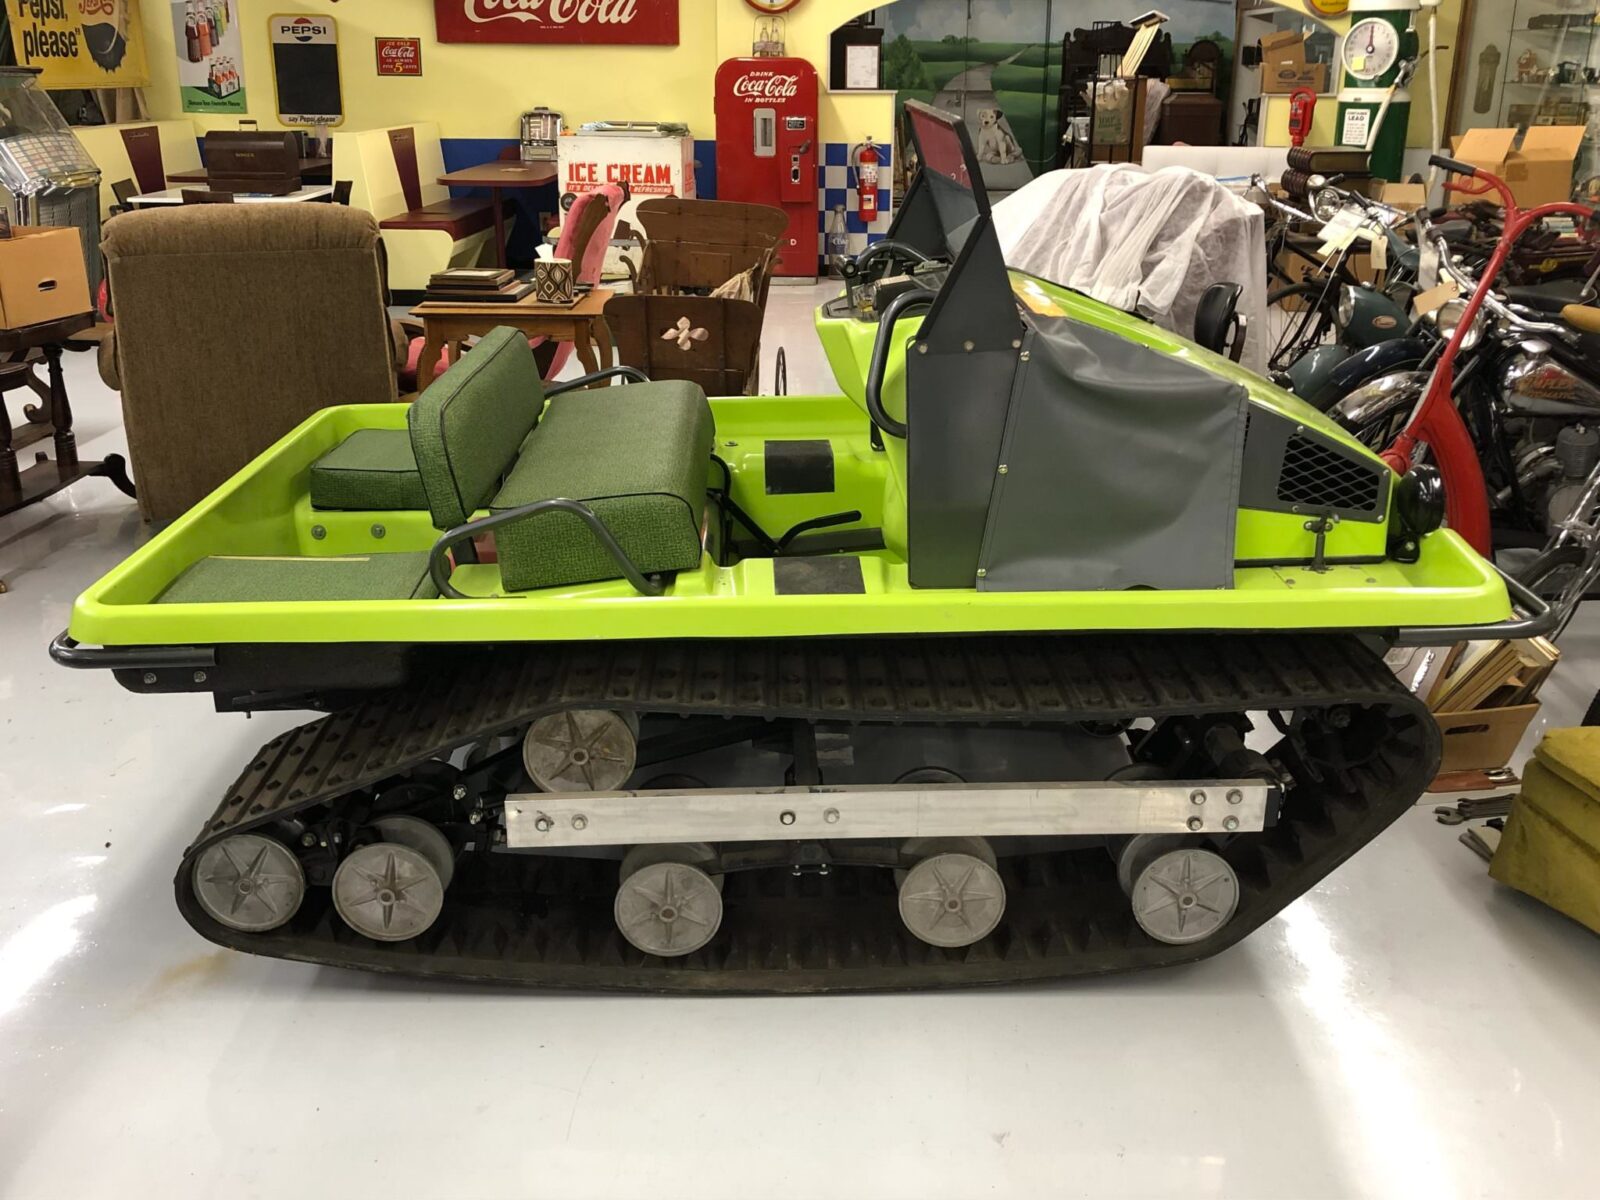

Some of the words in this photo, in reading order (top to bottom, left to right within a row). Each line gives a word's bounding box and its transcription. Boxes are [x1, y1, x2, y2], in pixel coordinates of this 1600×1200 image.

[464, 0, 637, 24] CCola
[281, 25, 327, 35] PEPSI
[393, 62, 403, 73] 5
[733, 75, 799, 97] Coca-Cola
[568, 163, 598, 182] ICE
[606, 163, 671, 184] CREAM
